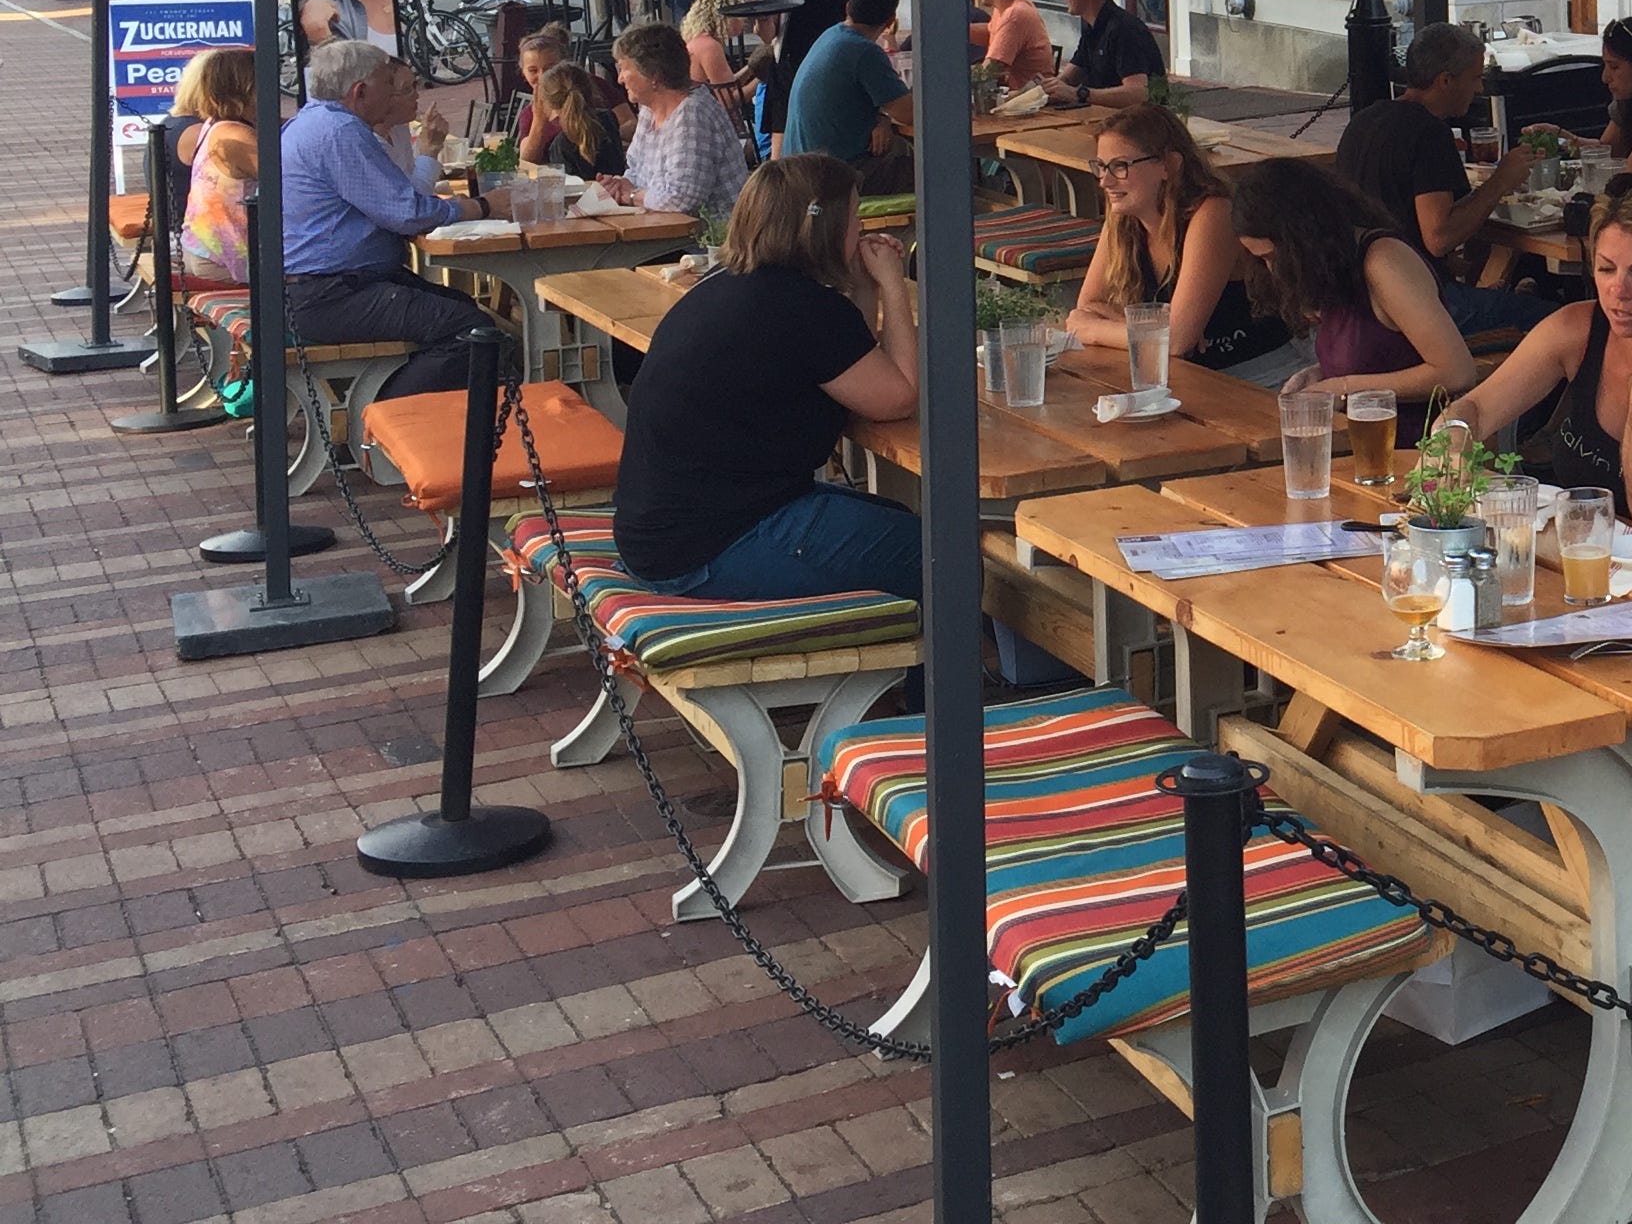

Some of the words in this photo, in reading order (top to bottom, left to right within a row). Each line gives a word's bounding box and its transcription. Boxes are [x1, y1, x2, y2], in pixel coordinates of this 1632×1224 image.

[119, 20, 244, 53] ZUCKERMAN
[126, 63, 186, 85] Pea
[150, 86, 176, 94] STAT
